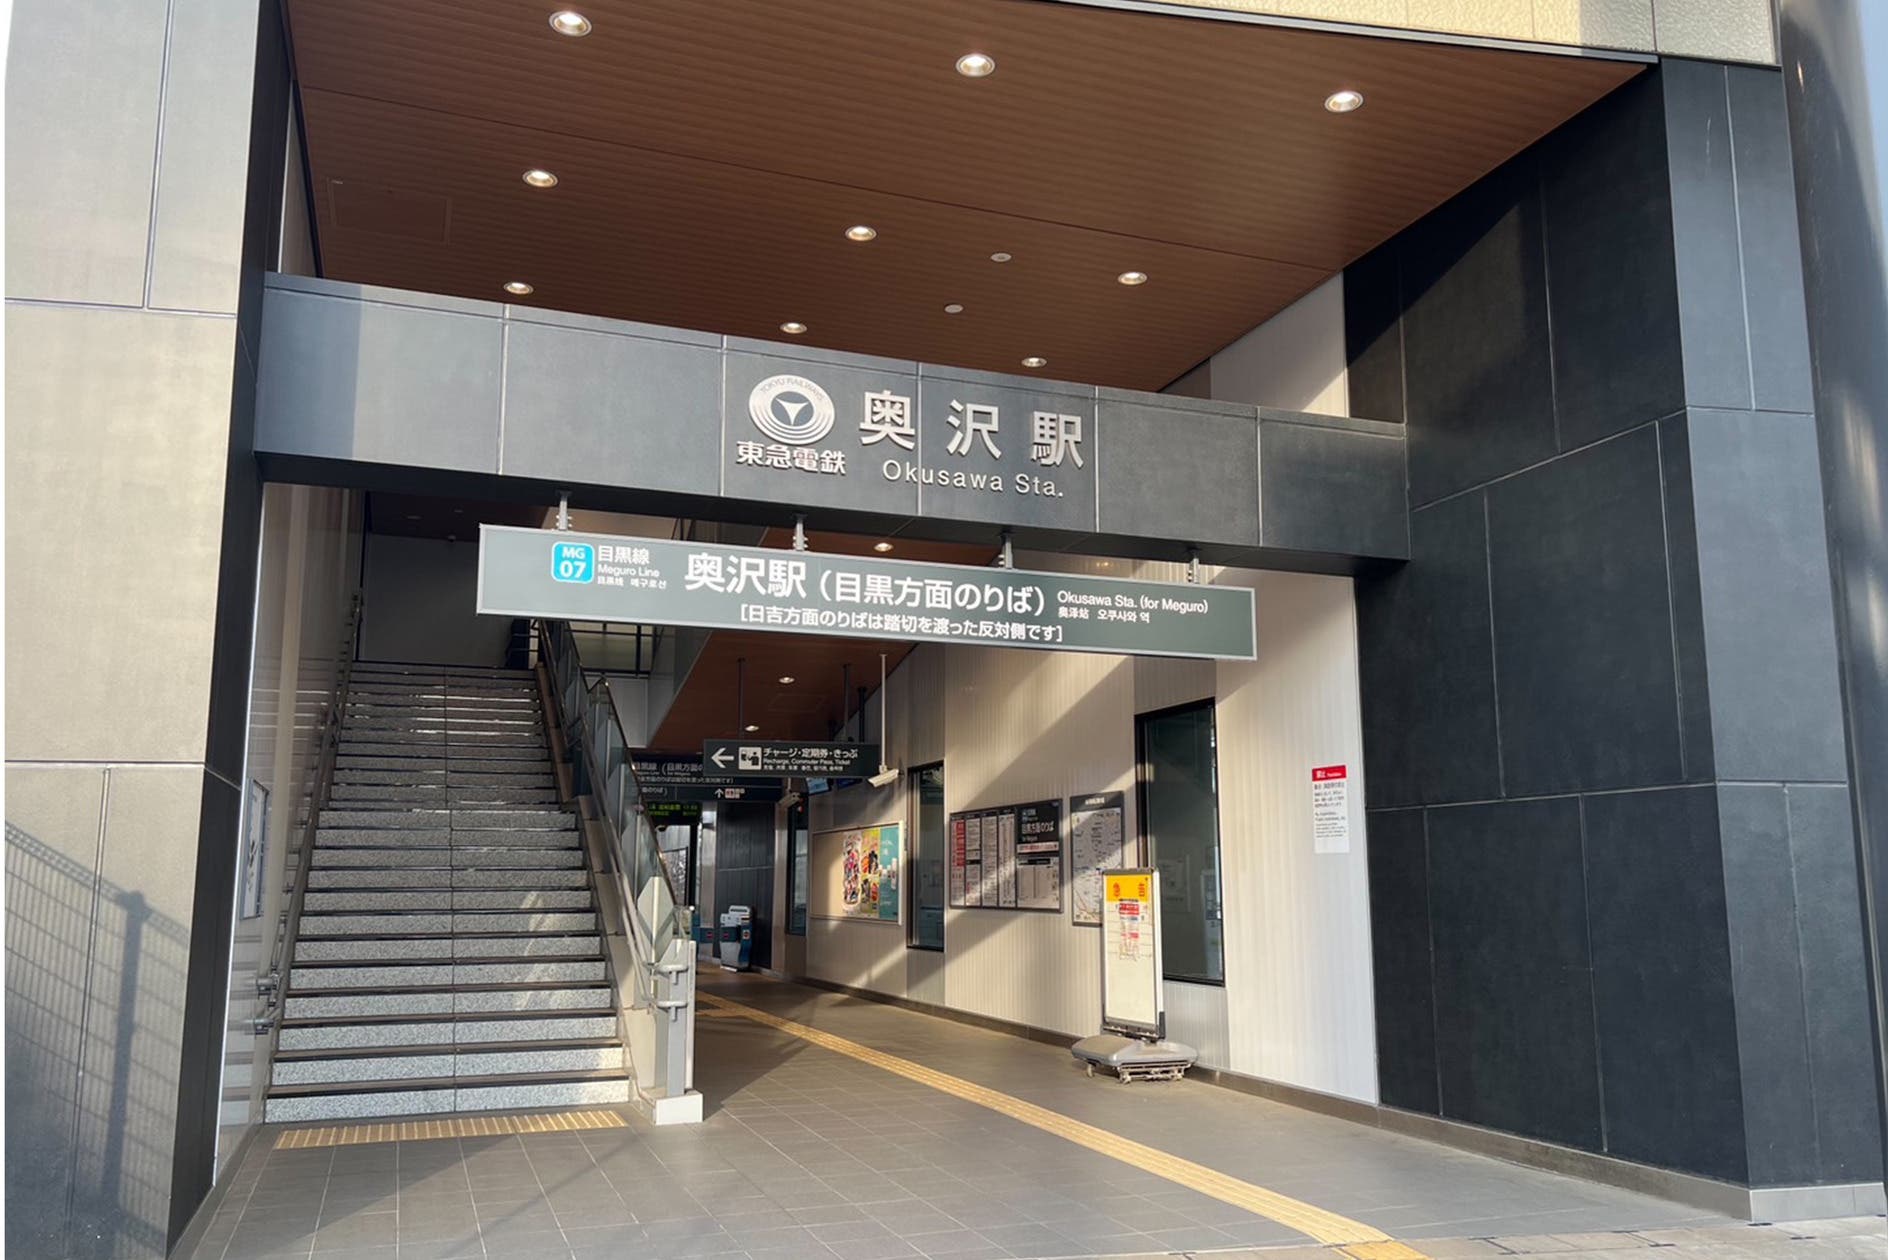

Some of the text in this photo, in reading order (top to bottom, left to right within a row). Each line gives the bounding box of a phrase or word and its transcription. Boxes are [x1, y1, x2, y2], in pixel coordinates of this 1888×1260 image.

[859, 389, 1084, 469] 奥沢駅
[736, 440, 847, 475] 東急電鉄
[883, 460, 1064, 498] Okusawa Sta.
[561, 546, 586, 560] MG
[598, 545, 650, 566] 目黒線
[559, 561, 587, 579] 07
[598, 564, 660, 578] Meguro Line
[1057, 590, 1208, 615] Okusawa Sta. (for Meguro)
